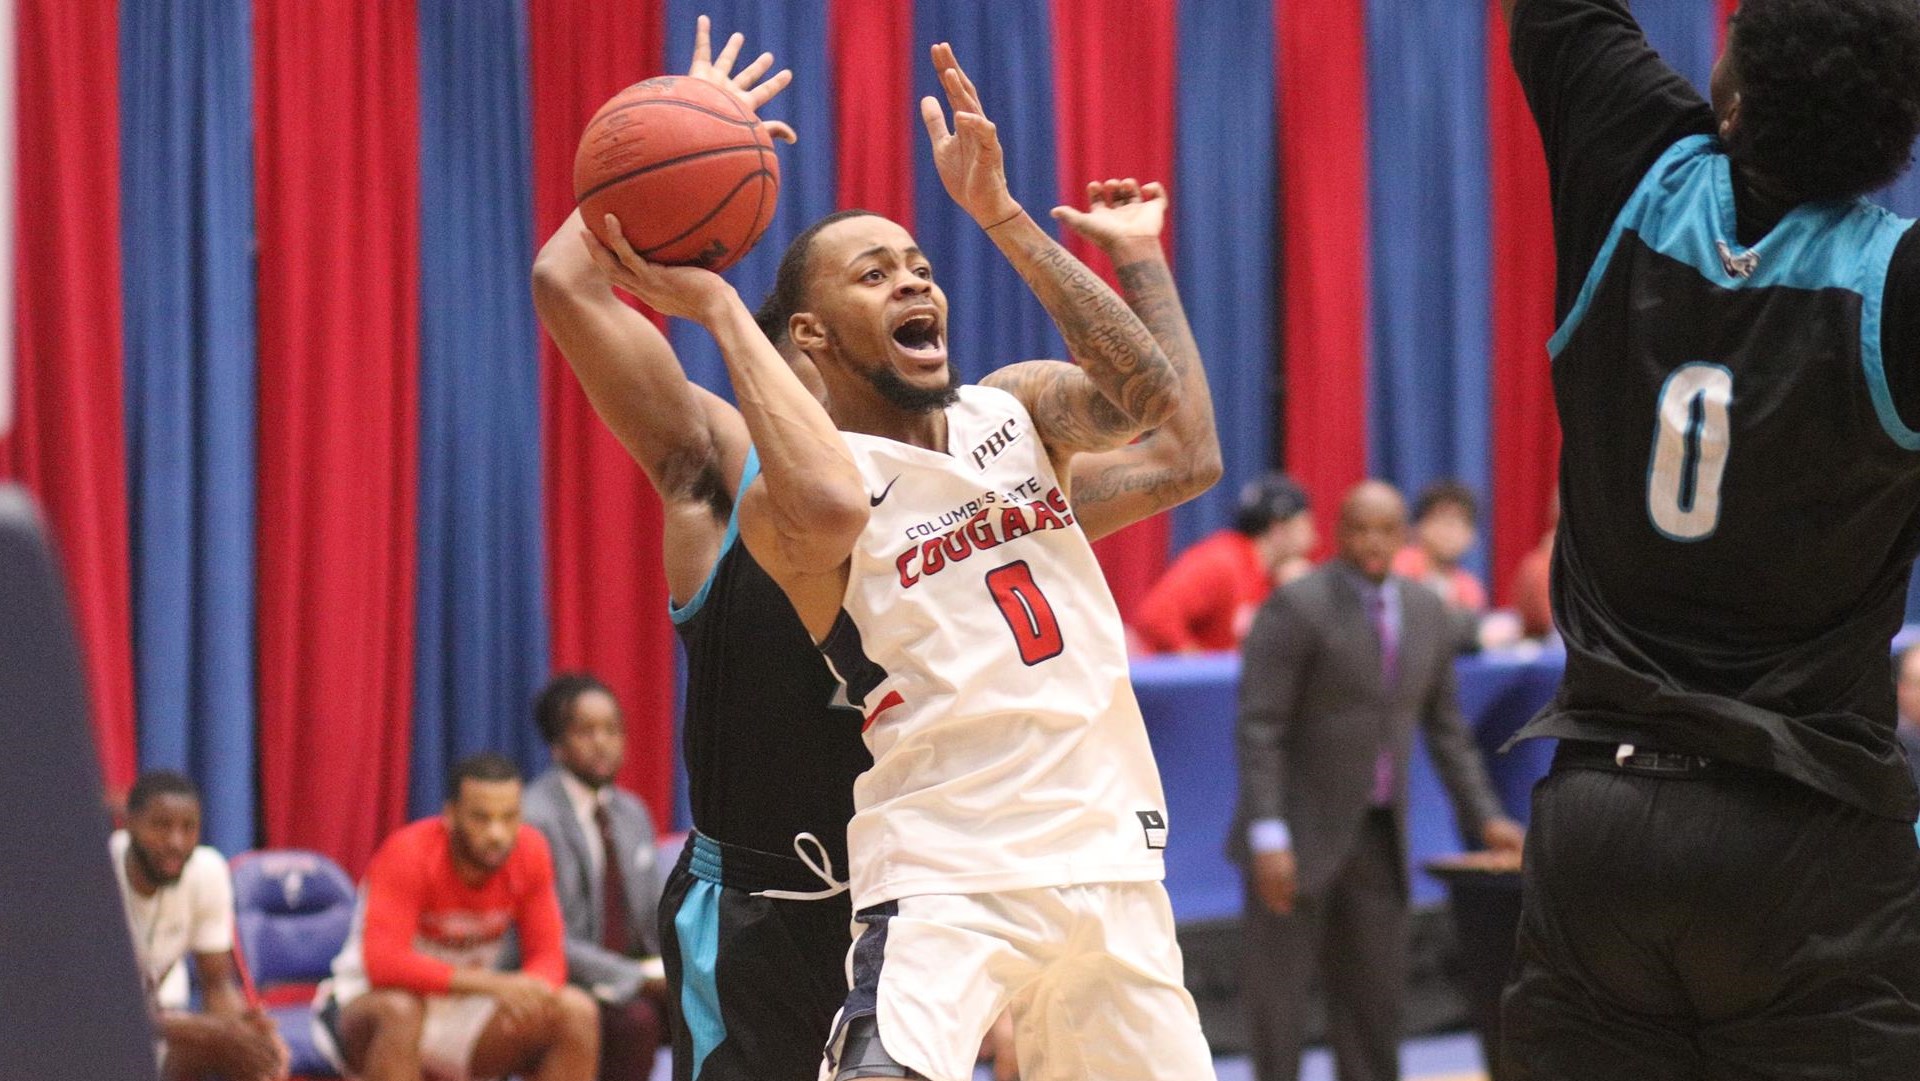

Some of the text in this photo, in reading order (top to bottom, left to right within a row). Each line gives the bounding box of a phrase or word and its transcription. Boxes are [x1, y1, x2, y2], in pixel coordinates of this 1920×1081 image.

[971, 418, 1022, 470] PBC
[1646, 361, 1733, 542] 0
[985, 559, 1064, 667] 0
[1146, 814, 1159, 826] L
